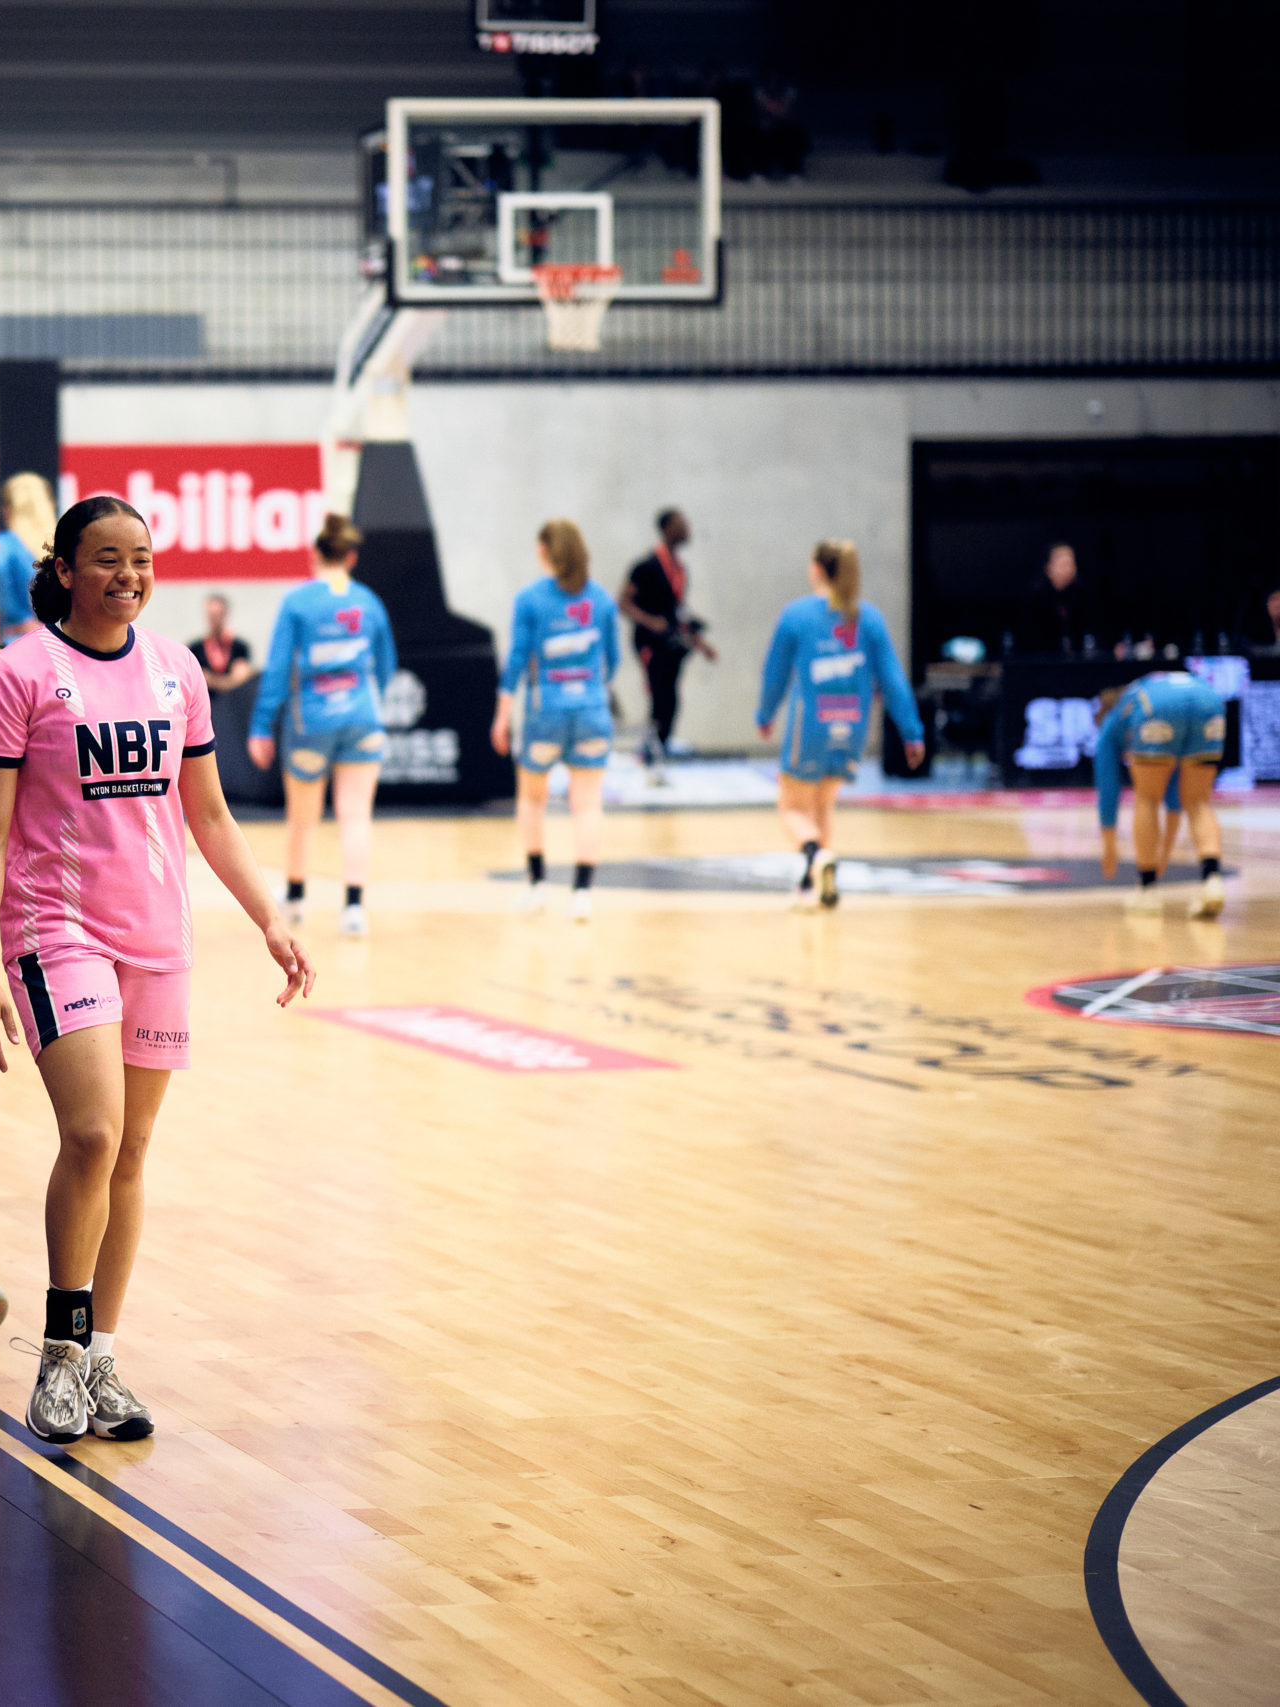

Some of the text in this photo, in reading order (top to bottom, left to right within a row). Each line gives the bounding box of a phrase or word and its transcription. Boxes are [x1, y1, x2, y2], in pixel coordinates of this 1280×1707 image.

[73, 719, 172, 779] NBF
[90, 785, 110, 796] NYON
[112, 783, 139, 794] BASKET
[64, 997, 97, 1012] net+
[135, 1027, 190, 1043] BURNIER
